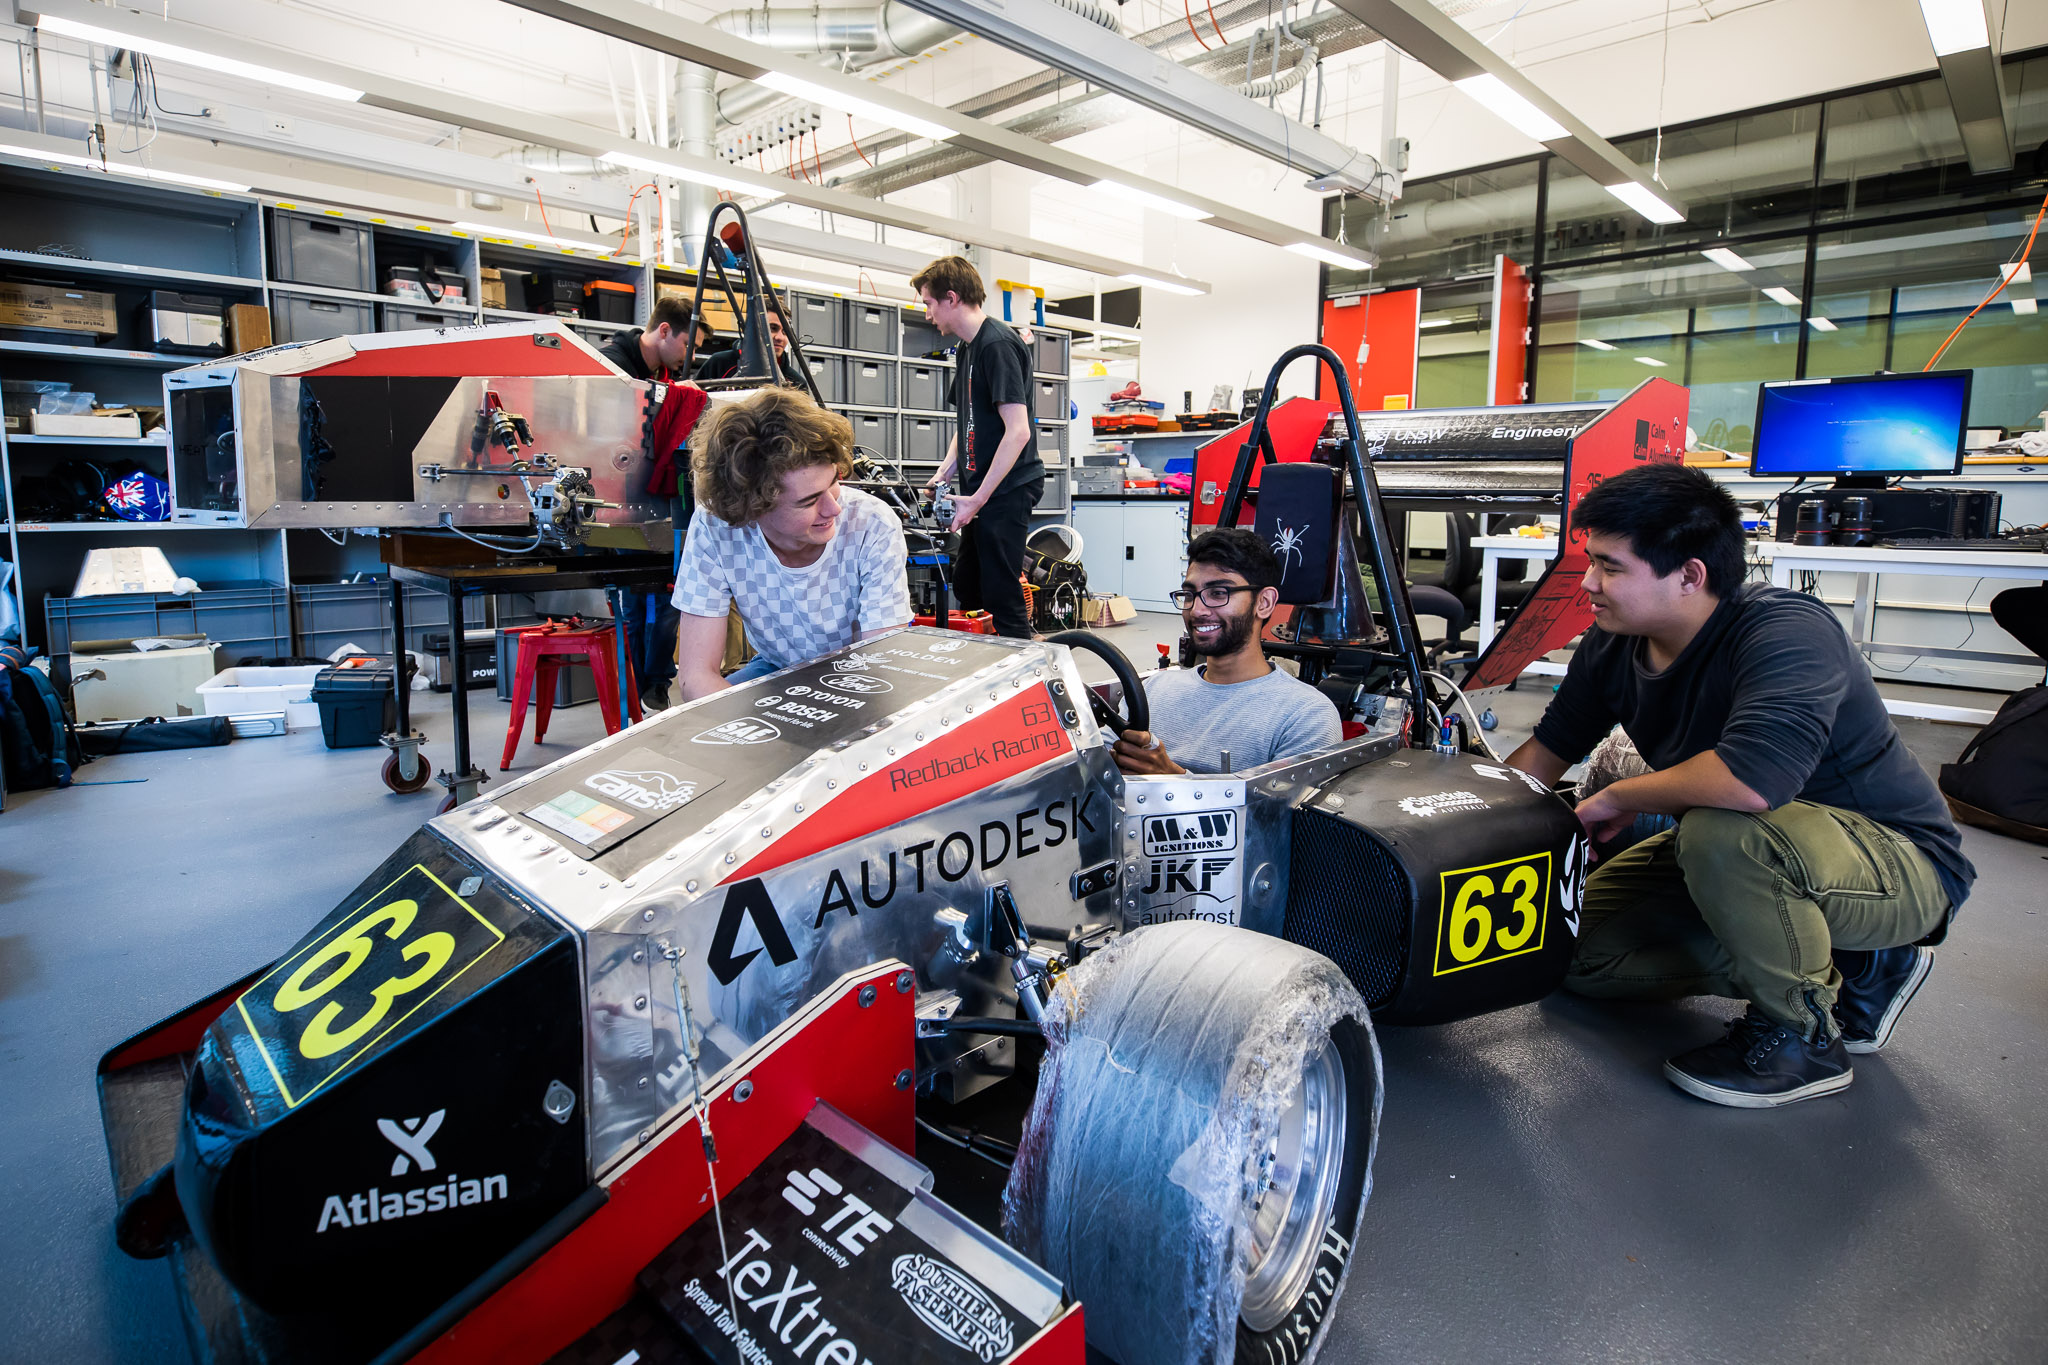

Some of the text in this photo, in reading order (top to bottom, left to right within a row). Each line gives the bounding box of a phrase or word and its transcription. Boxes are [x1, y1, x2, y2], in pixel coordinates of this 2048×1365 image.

[1395, 427, 1449, 441] UNSW
[1651, 423, 1666, 440] Calm
[886, 648, 963, 665] HOLDEN
[472, 668, 497, 678] POW
[827, 675, 882, 692] Ford
[776, 701, 839, 722] BOSCH
[807, 691, 866, 709] TOYOTA
[1021, 702, 1052, 727] 63
[716, 721, 776, 741] SAE
[889, 730, 1061, 793] Redback Racing
[1404, 790, 1478, 807] Sprockets
[1441, 803, 1491, 814] AUSTRALIA
[1154, 839, 1224, 853] IGNITIONS
[813, 790, 1097, 929] AUTODESK
[1140, 857, 1237, 894] JKF
[1140, 909, 1235, 925] autofrost
[1449, 865, 1539, 963] 63
[273, 899, 456, 1060] 63
[316, 1174, 508, 1233] Atlassian
[820, 1193, 894, 1257] TE
[802, 1227, 850, 1269] connectivity
[683, 1278, 722, 1317] Spread
[713, 1308, 737, 1337] Tow
[715, 1227, 873, 1365] TeXtre
[908, 1253, 1015, 1340] SOUTHERN
[890, 1271, 998, 1363] FASTENERS
